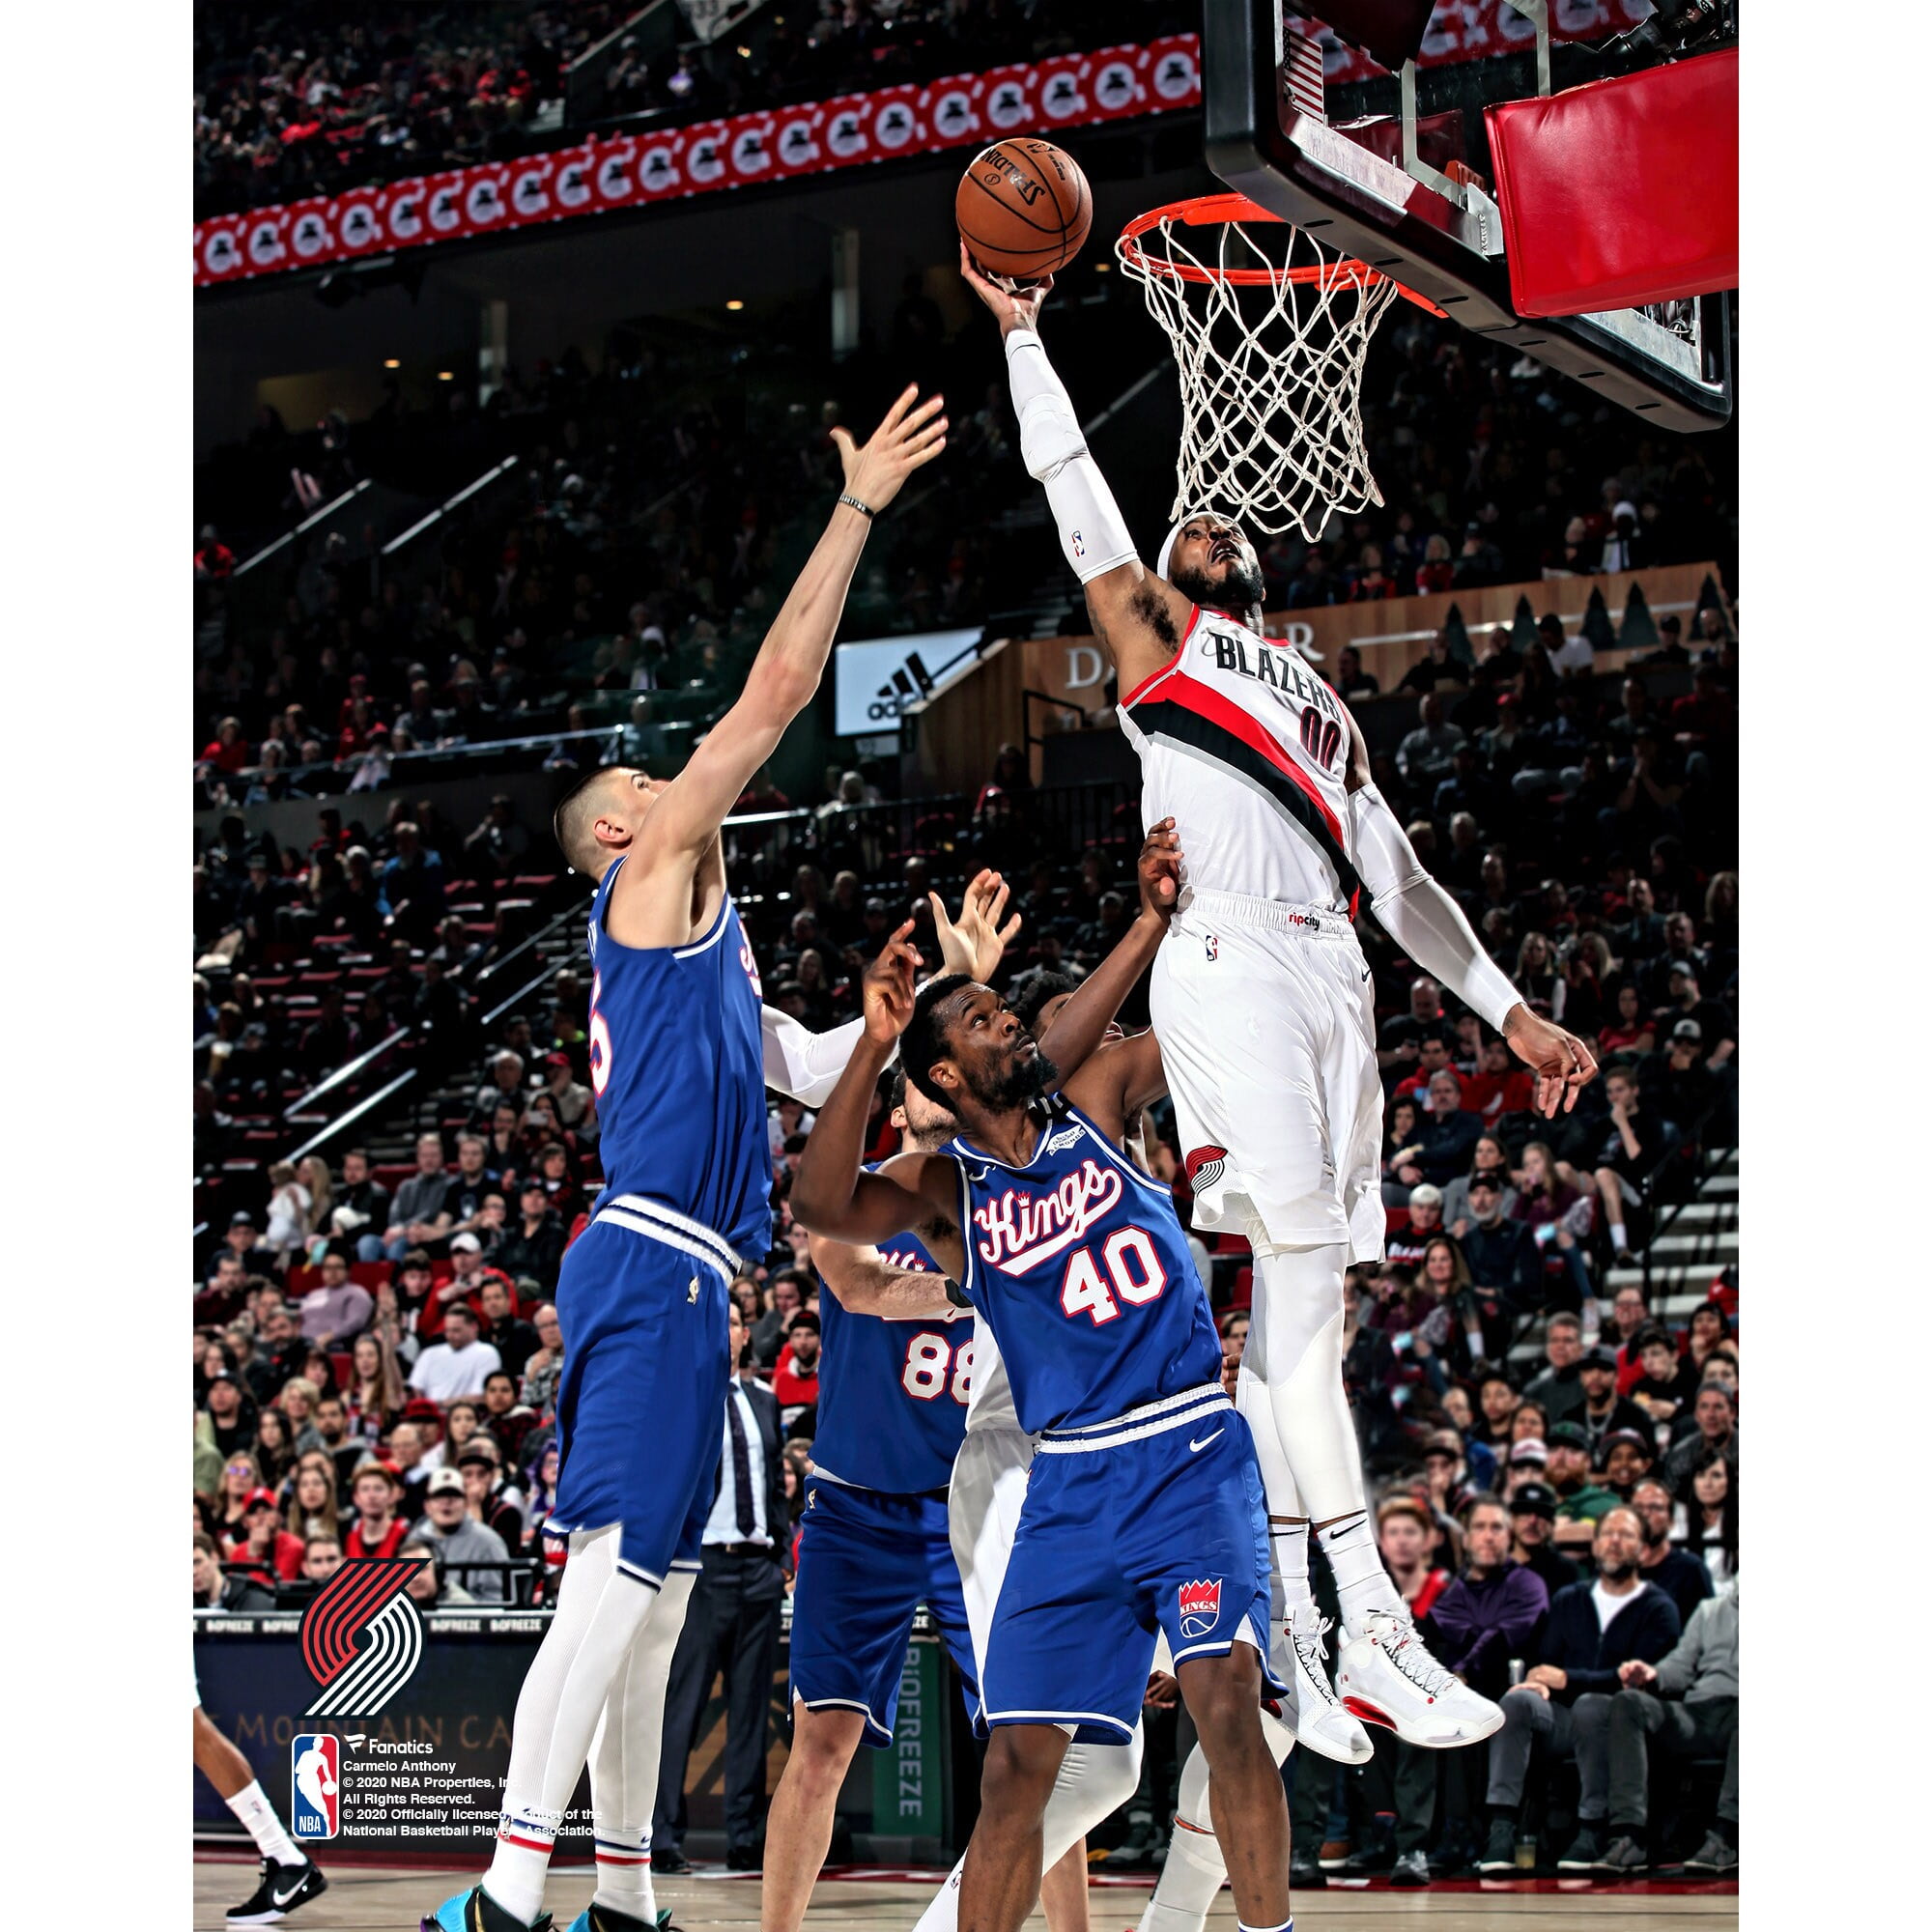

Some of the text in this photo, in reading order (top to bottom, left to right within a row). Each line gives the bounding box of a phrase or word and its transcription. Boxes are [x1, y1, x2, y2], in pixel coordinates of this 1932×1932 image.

[1209, 632, 1342, 724] BLAZERS
[1300, 706, 1342, 773] 00
[974, 1158, 1123, 1278] Kings
[1059, 1224, 1169, 1328] 40
